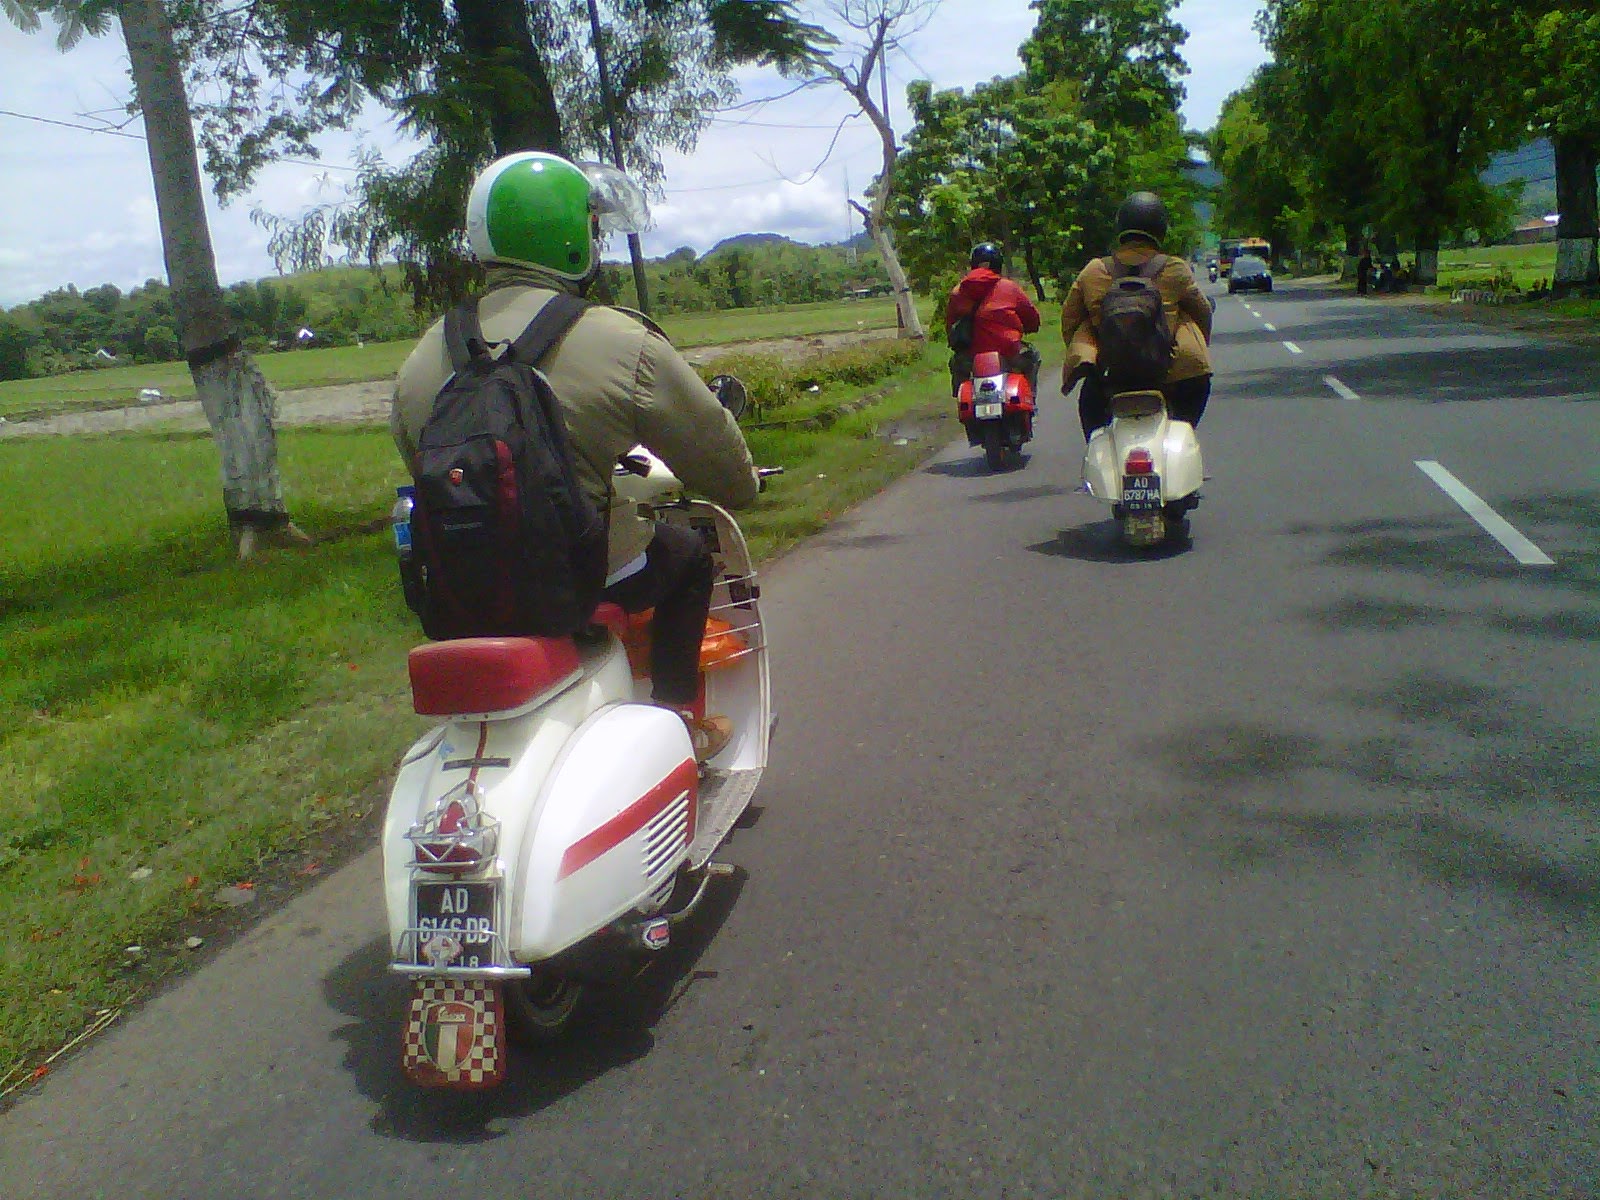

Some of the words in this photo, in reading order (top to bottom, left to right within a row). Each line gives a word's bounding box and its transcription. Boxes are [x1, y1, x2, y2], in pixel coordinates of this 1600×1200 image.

[1134, 477, 1148, 488] AD
[441, 888, 469, 914] AD
[466, 917, 490, 943] DB
